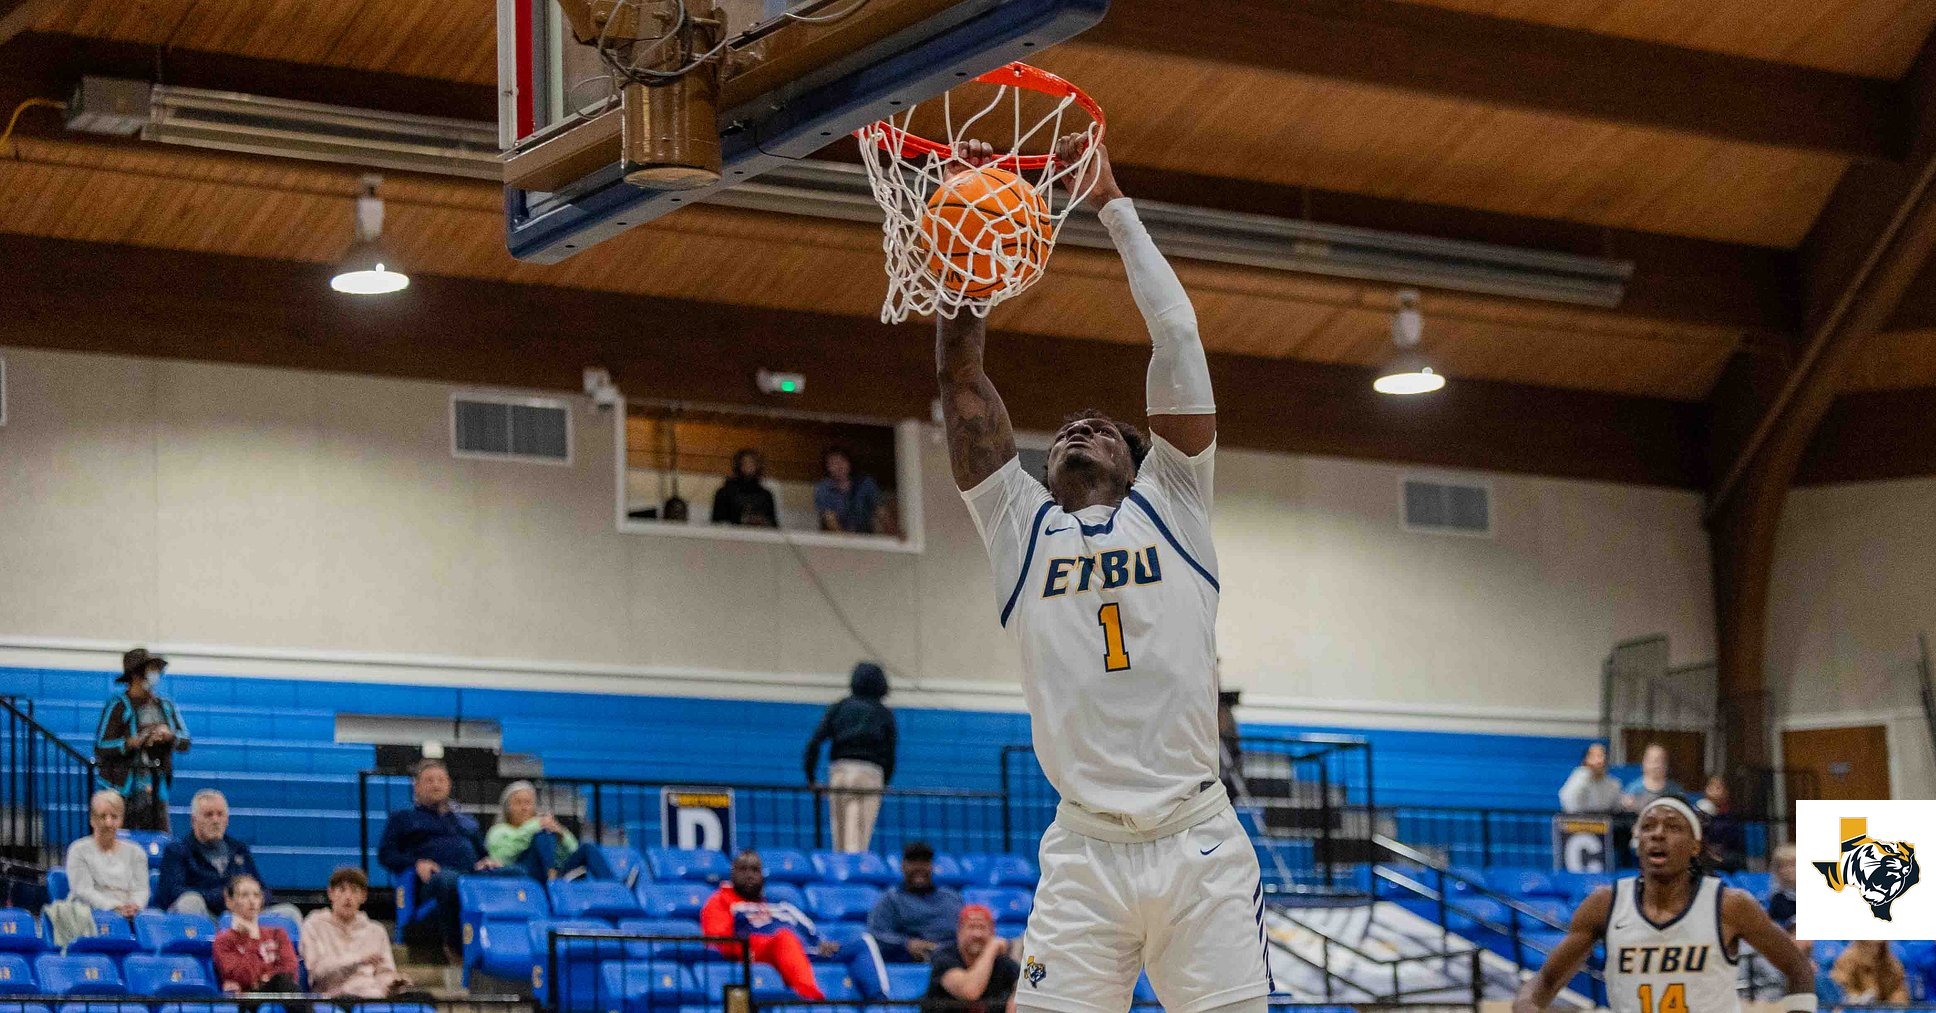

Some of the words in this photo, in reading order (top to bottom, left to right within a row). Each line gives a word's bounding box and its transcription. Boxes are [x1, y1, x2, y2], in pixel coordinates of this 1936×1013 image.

[1041, 545, 1163, 599] ETBU
[1098, 602, 1131, 672] 1
[677, 807, 723, 851] D
[1564, 832, 1604, 874] C
[1618, 945, 1710, 974] ETBU
[1637, 983, 1689, 1013] 14
